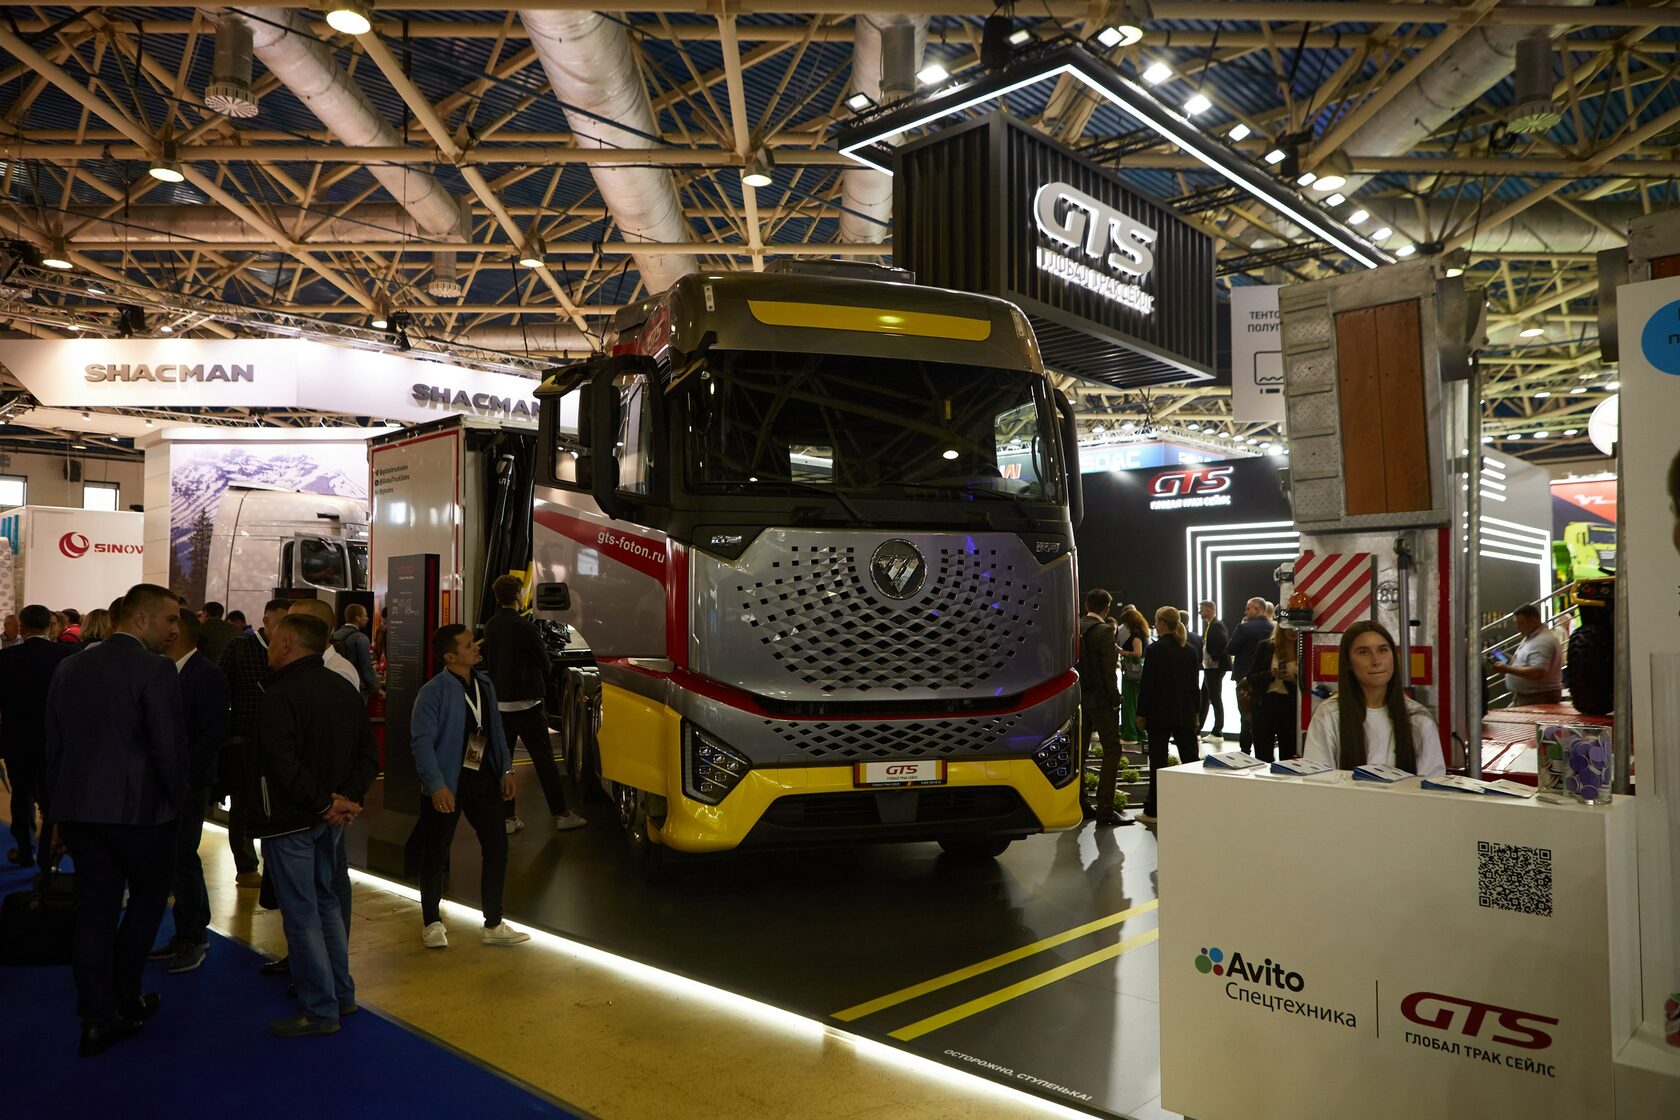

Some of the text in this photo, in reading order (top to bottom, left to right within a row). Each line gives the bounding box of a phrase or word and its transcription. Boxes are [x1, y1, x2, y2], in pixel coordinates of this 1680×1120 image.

[1034, 182, 1158, 277] GTS
[84, 363, 255, 383] SHACMAN
[1147, 465, 1234, 498] GTS
[597, 532, 666, 564] gts-foton.ru
[886, 765, 918, 775] GTS
[1226, 952, 1304, 992] Avito
[1225, 982, 1357, 1028] Спецтехника
[1400, 991, 1559, 1050] GTS
[1405, 1032, 1556, 1078] ГЛОБАЛ ТРАК СЕЙЛС
[1016, 1073, 1092, 1101] СТУПЕНЬКА!
